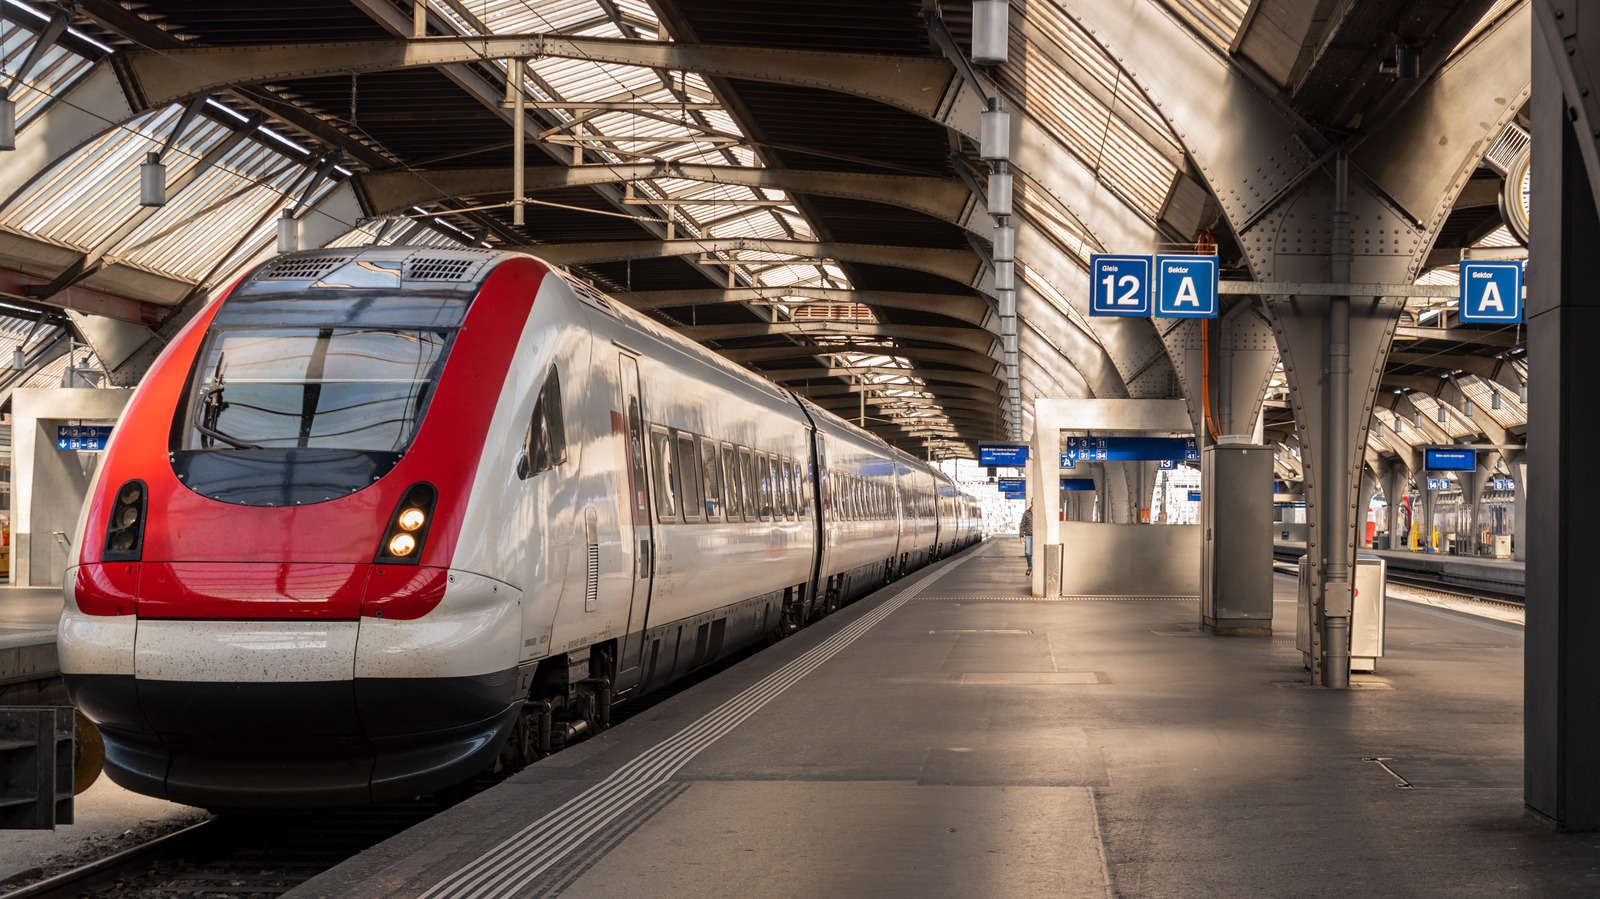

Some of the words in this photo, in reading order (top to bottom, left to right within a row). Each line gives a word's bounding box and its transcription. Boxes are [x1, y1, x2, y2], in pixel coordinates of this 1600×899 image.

[1102, 274, 1140, 305] 12
[1173, 276, 1200, 307] A
[1478, 281, 1504, 311] A
[1064, 458, 1071, 466] A
[1160, 460, 1171, 468] 13
